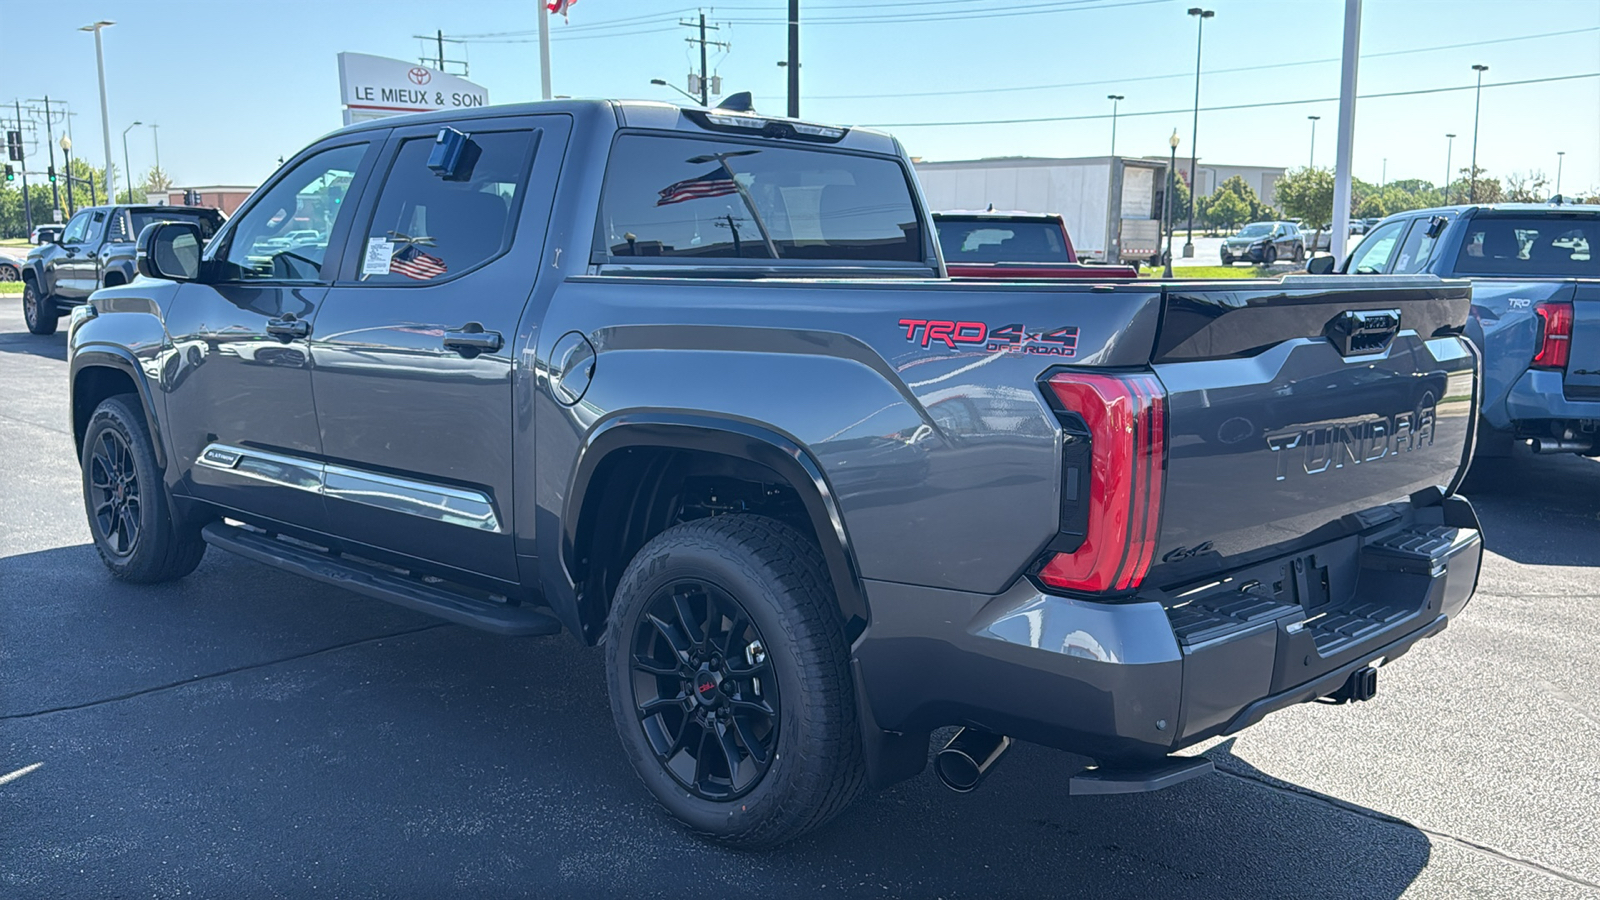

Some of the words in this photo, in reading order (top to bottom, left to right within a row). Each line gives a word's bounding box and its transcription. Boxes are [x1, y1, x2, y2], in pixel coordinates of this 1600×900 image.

[355, 86, 375, 101] LE
[381, 88, 428, 104] MIEUX
[435, 91, 445, 105] &
[452, 93, 483, 107] SON
[1508, 297, 1531, 309] TRD
[898, 319, 989, 351] TRD
[986, 343, 1021, 354] OFF
[1023, 345, 1077, 357] ROAD
[1267, 406, 1437, 481] TUNDRA
